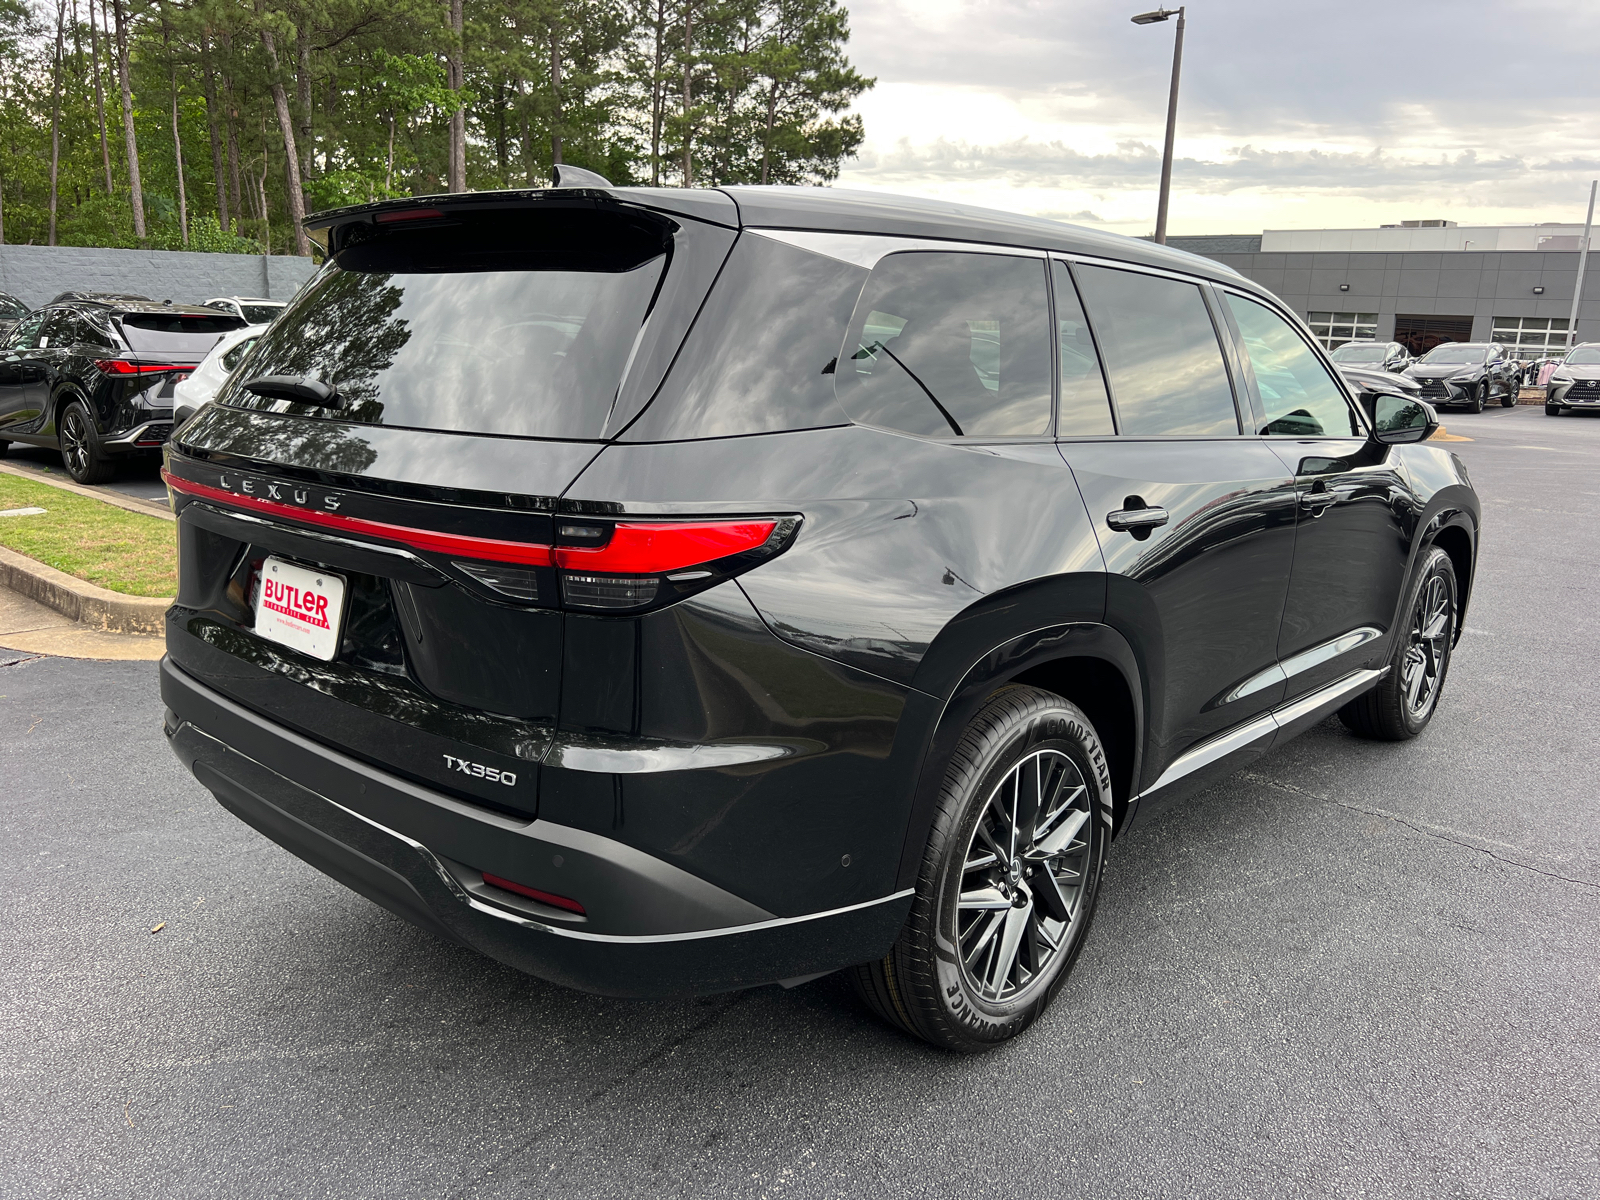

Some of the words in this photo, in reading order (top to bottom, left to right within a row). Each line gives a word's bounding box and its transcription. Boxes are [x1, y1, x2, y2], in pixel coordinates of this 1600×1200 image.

[220, 475, 341, 511] LEXUS
[305, 614, 329, 629] GROUP
[442, 754, 517, 787] TX350
[1046, 718, 1110, 792] GOODYEAR
